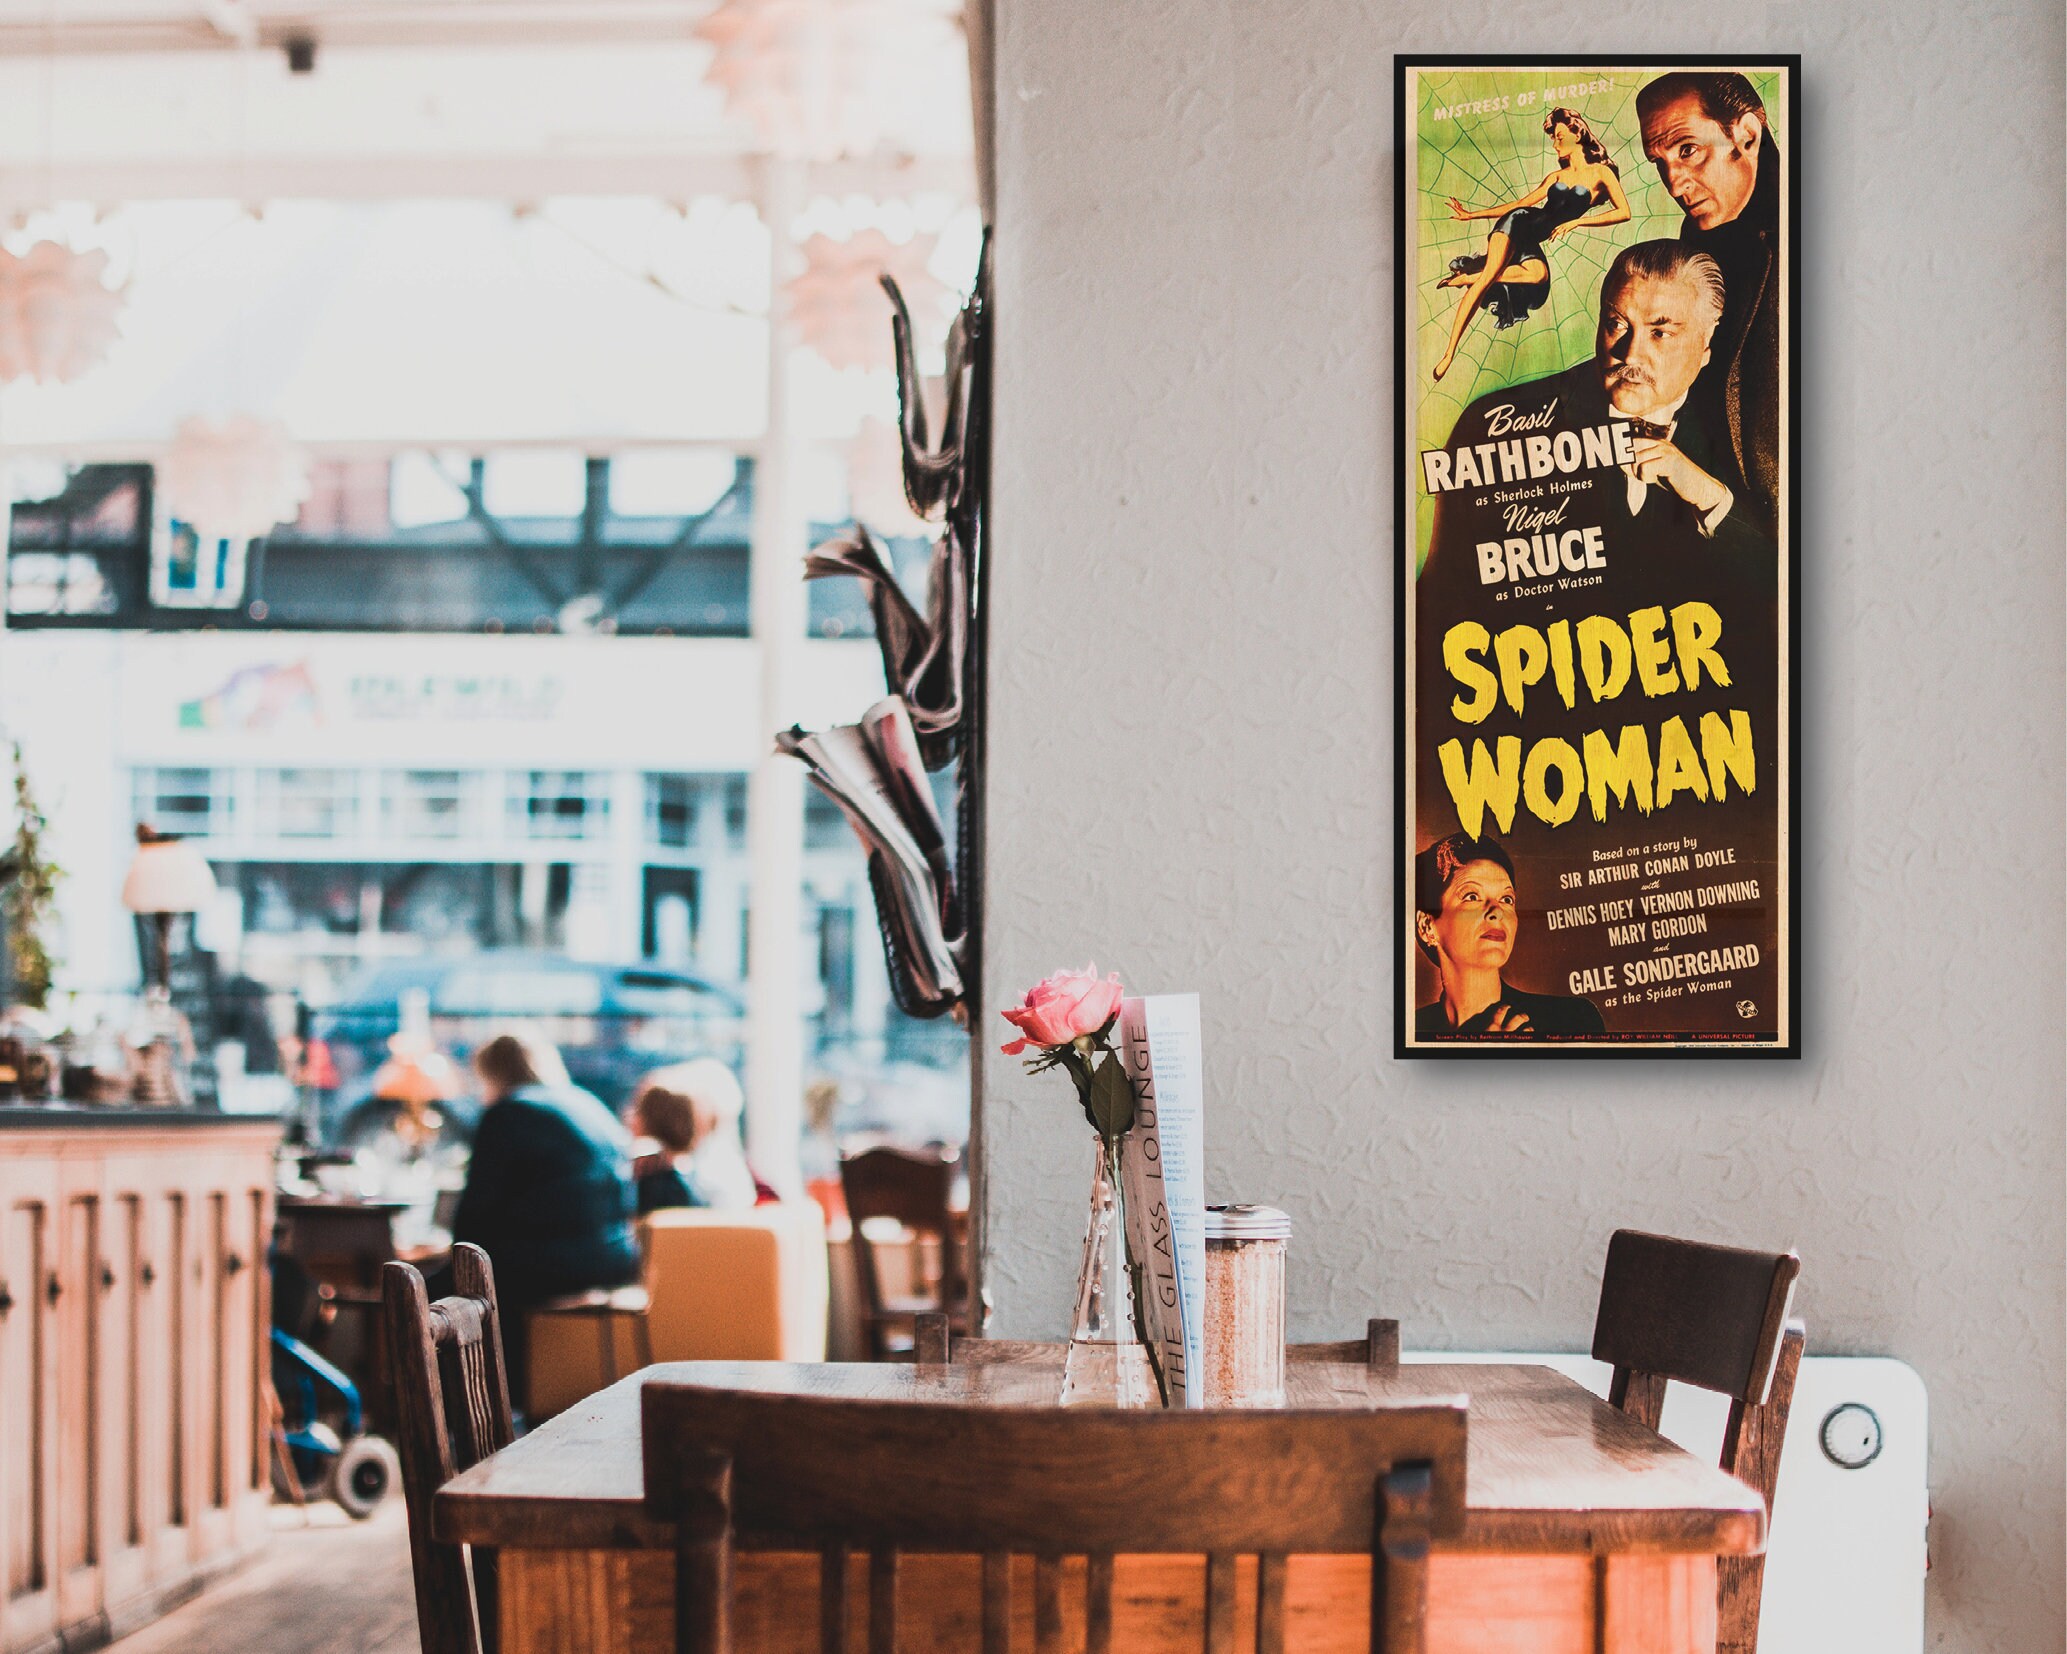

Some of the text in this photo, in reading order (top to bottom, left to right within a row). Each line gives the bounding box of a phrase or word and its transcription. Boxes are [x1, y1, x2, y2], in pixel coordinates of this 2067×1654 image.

[1433, 77, 1615, 121] MISTRESS OF MURDER!
[1484, 397, 1558, 438] Basil
[1422, 421, 1636, 495] RATHBONE
[1475, 479, 1593, 507] as Sherlock Holmes
[1502, 496, 1570, 534] Nigel
[1475, 526, 1607, 585] BRUCE
[1495, 575, 1603, 602] as Doctor Watson
[1442, 601, 1733, 726] SPIDER
[1437, 708, 1756, 843] WOMAN
[1559, 848, 1737, 890] SIR ARTHUR CONAN DOYLE
[1592, 836, 1698, 862] Based on a story by
[1547, 879, 1760, 931] DENNIS HOEY VERNON DOWNING
[1640, 879, 1661, 891] with
[1607, 913, 1708, 947] MARY GORDON
[1652, 942, 1670, 953] and
[1568, 943, 1760, 996] GALE SONDERGAARD
[1604, 979, 1733, 1008] as the Spider Woman
[1130, 1024, 1162, 1180] LOUNGE
[1148, 1200, 1177, 1308] GLASS
[1163, 1323, 1188, 1392] THE
